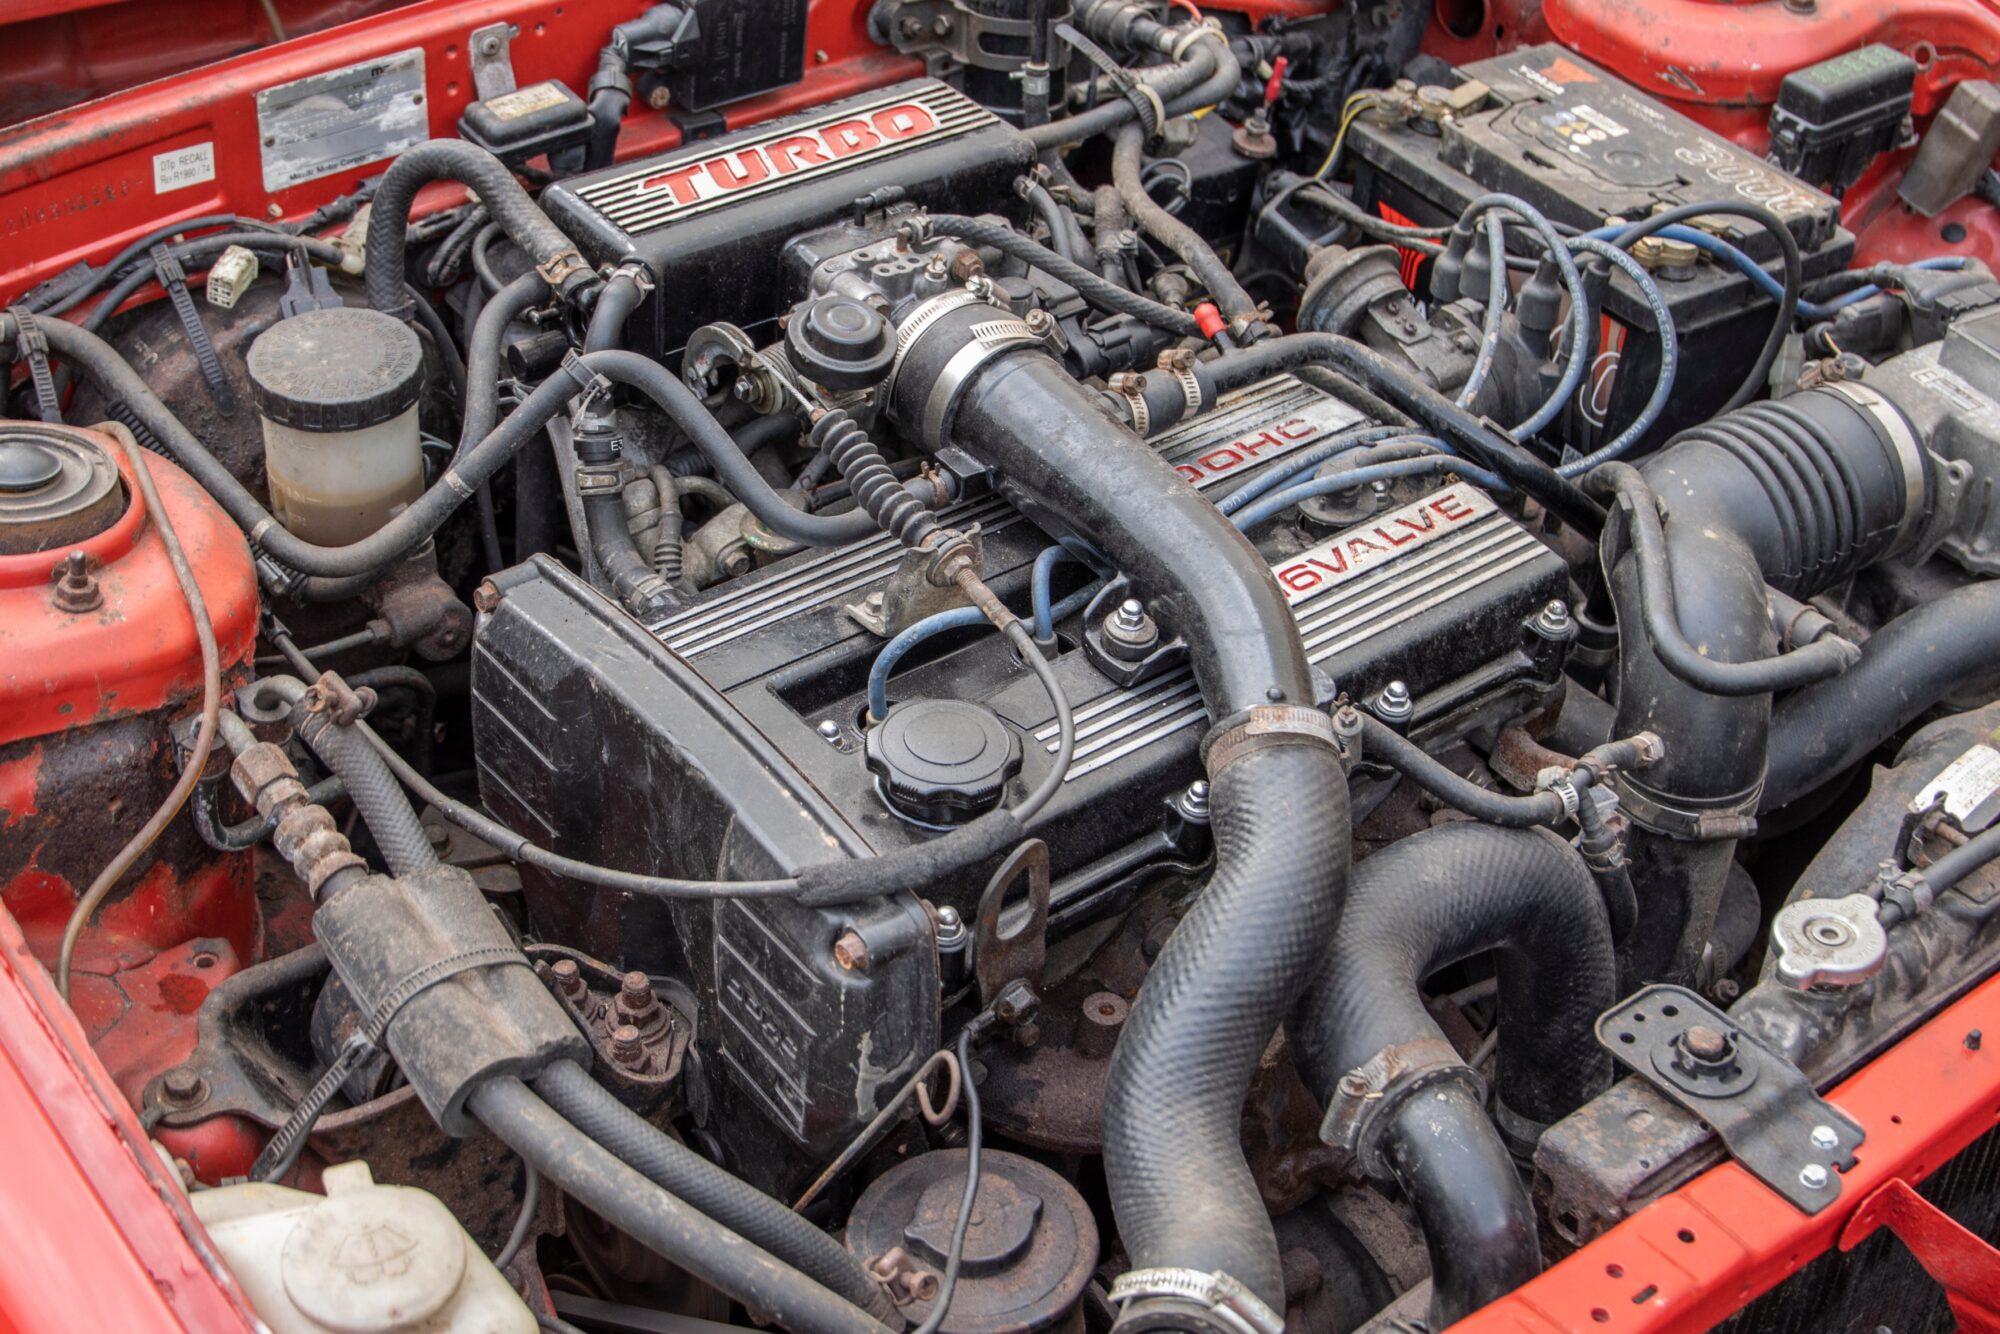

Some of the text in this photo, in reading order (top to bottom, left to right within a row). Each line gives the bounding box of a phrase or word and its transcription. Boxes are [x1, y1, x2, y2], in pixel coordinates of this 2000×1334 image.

[179, 151, 208, 166] RECALL
[643, 104, 934, 204] TURBO
[1279, 493, 1475, 594] 6VALVE
